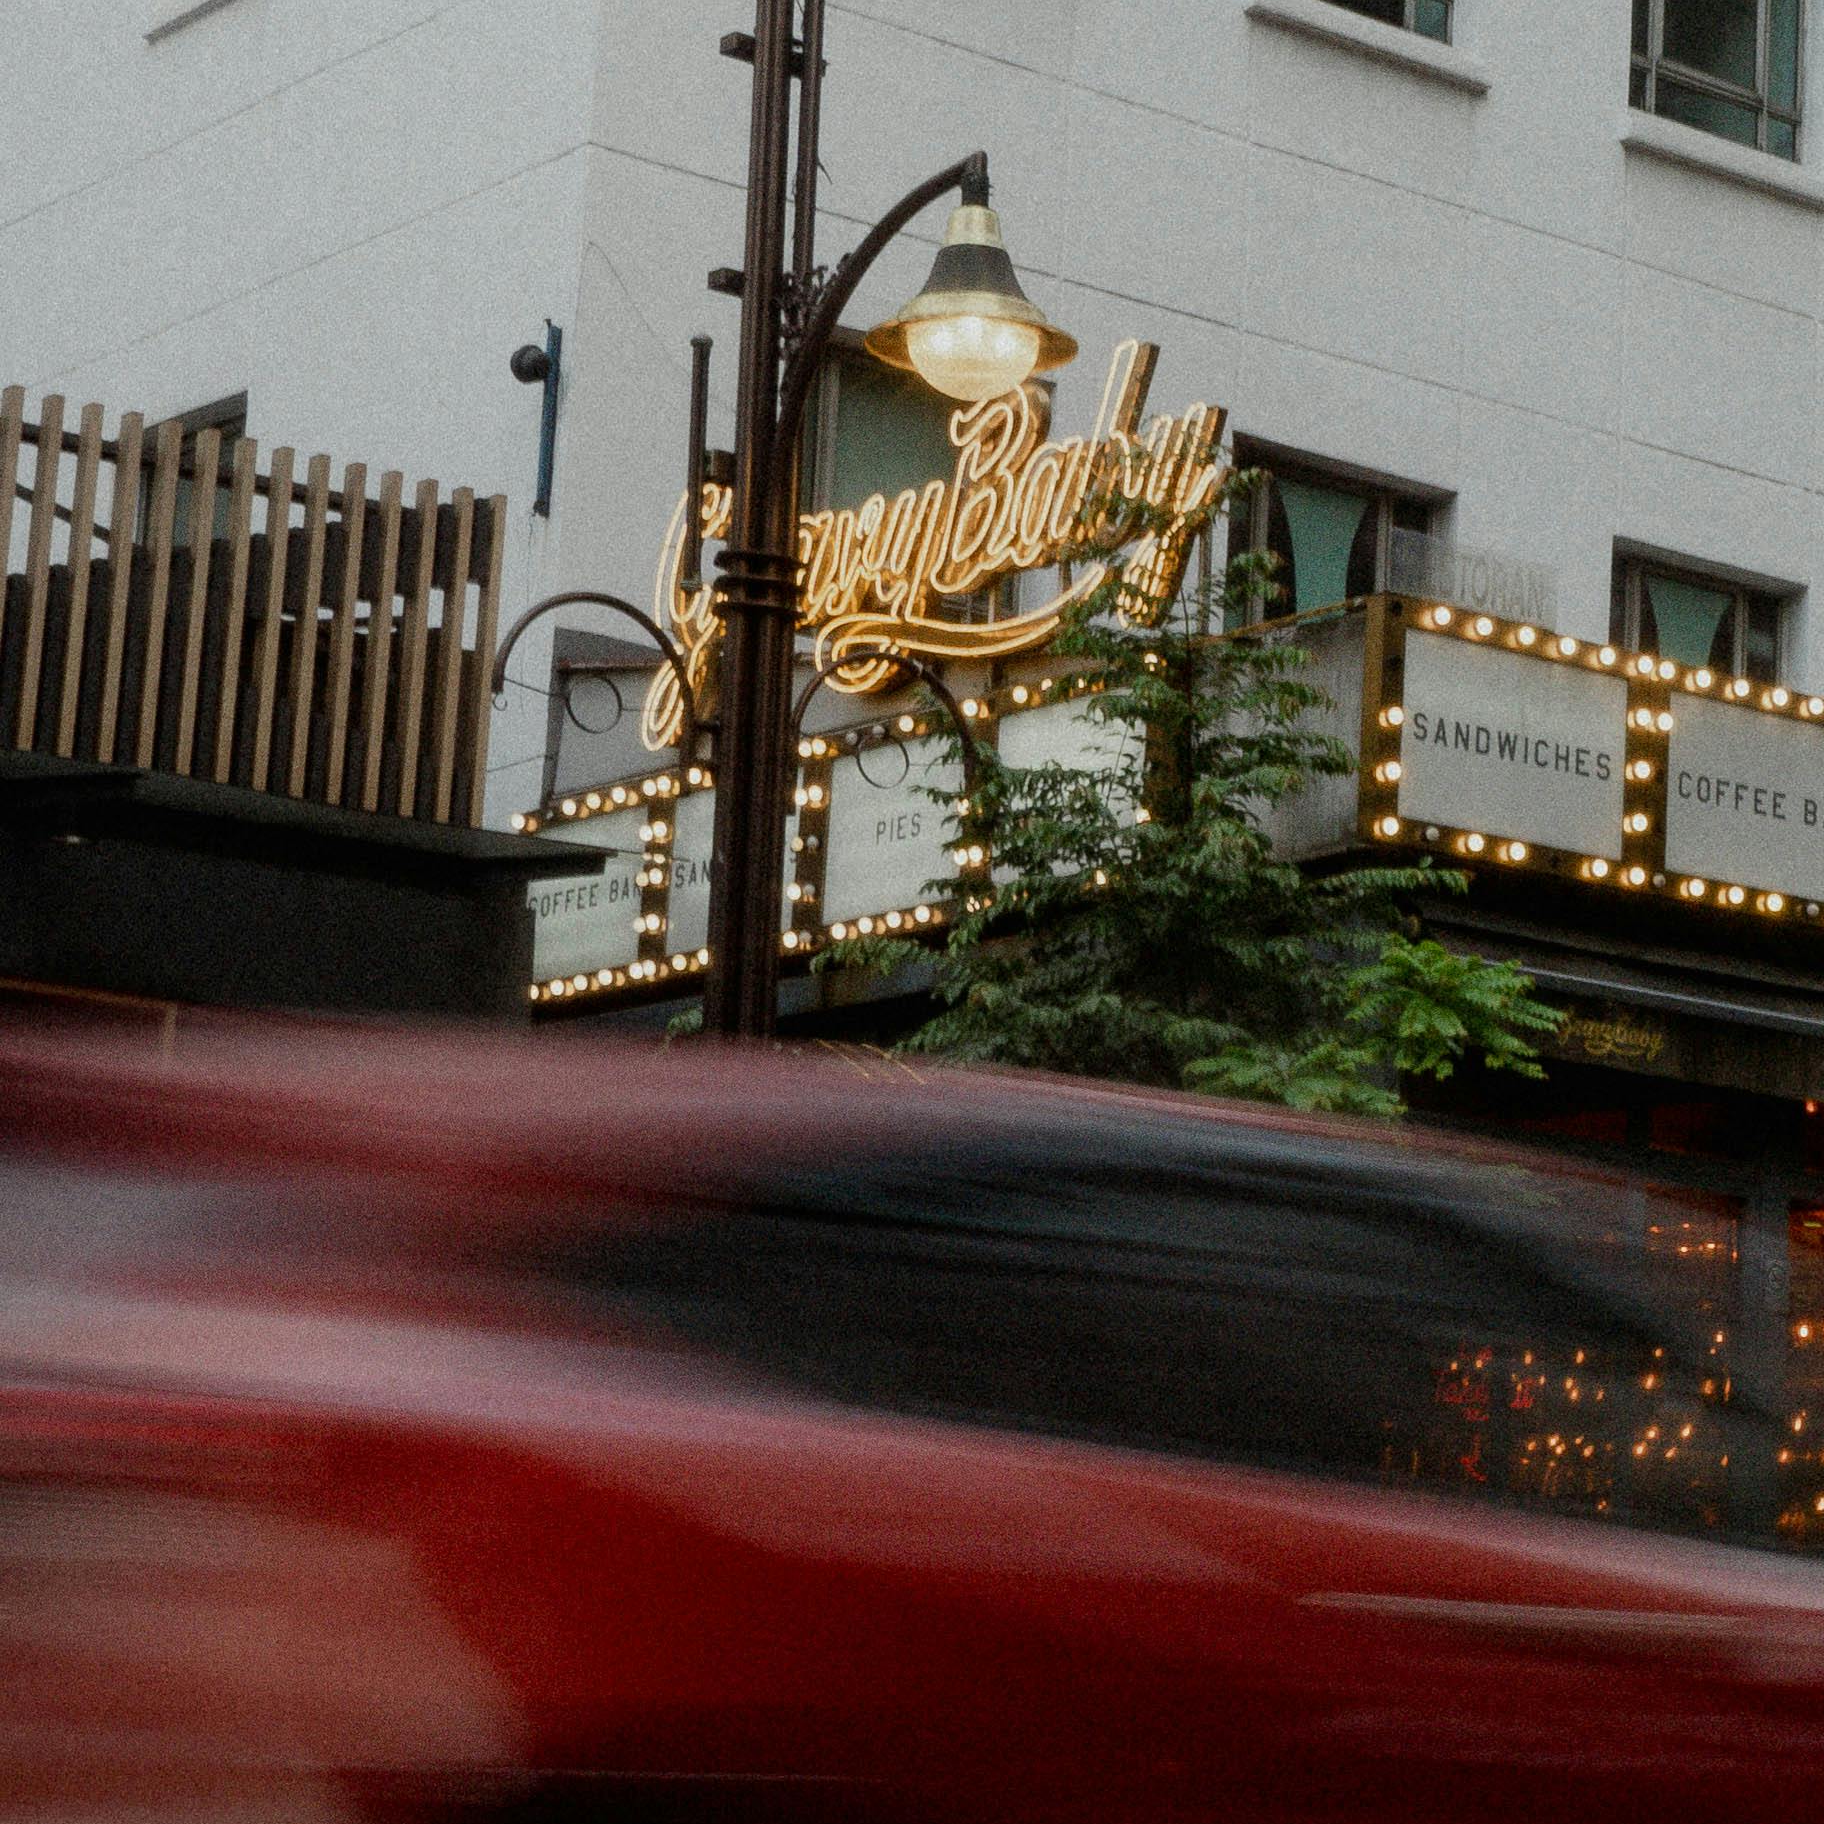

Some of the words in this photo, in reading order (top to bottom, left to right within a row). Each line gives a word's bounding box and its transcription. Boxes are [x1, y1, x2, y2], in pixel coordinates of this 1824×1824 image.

[1413, 712, 1612, 782] SANDWICHES
[1677, 771, 1788, 821] COFFEE
[875, 812, 922, 844] PIES
[529, 884, 599, 918] COFFEE
